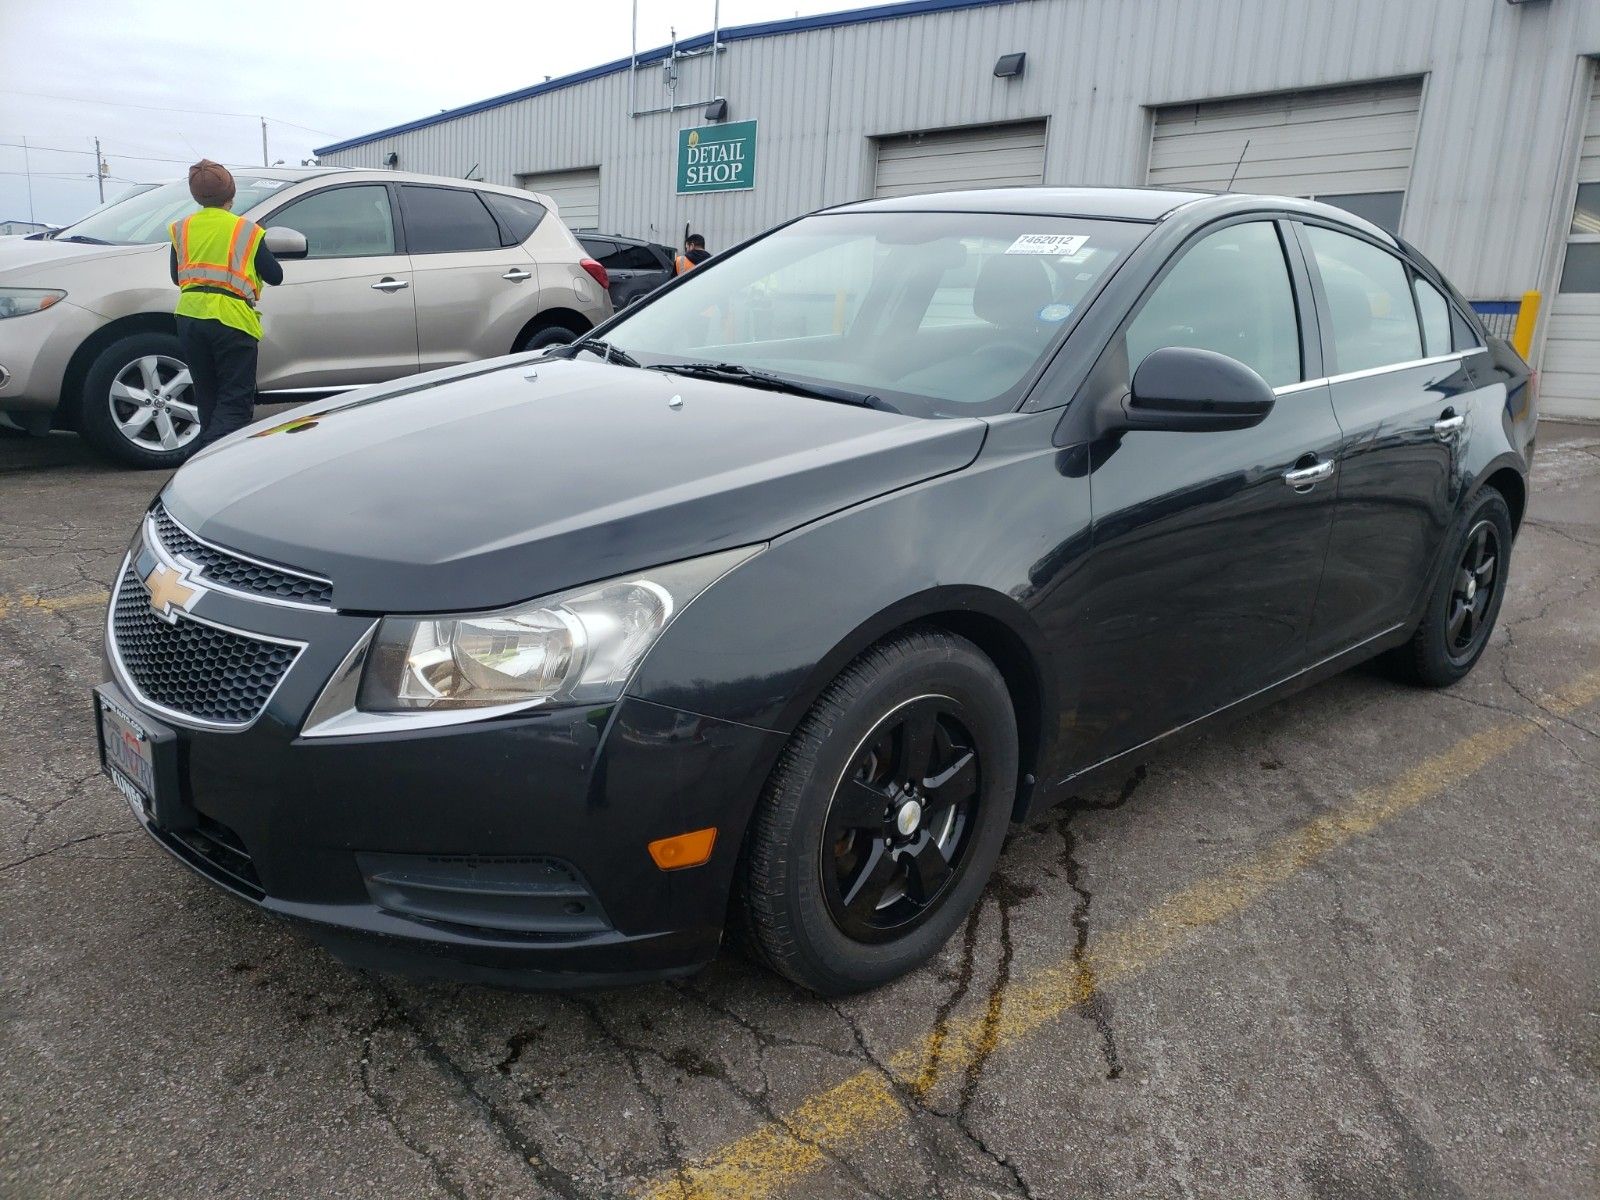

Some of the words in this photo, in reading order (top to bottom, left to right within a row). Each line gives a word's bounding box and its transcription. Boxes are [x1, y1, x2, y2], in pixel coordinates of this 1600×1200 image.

[687, 142, 745, 165] DETAIL
[686, 162, 743, 184] SHOP
[1018, 235, 1074, 245] 7462012
